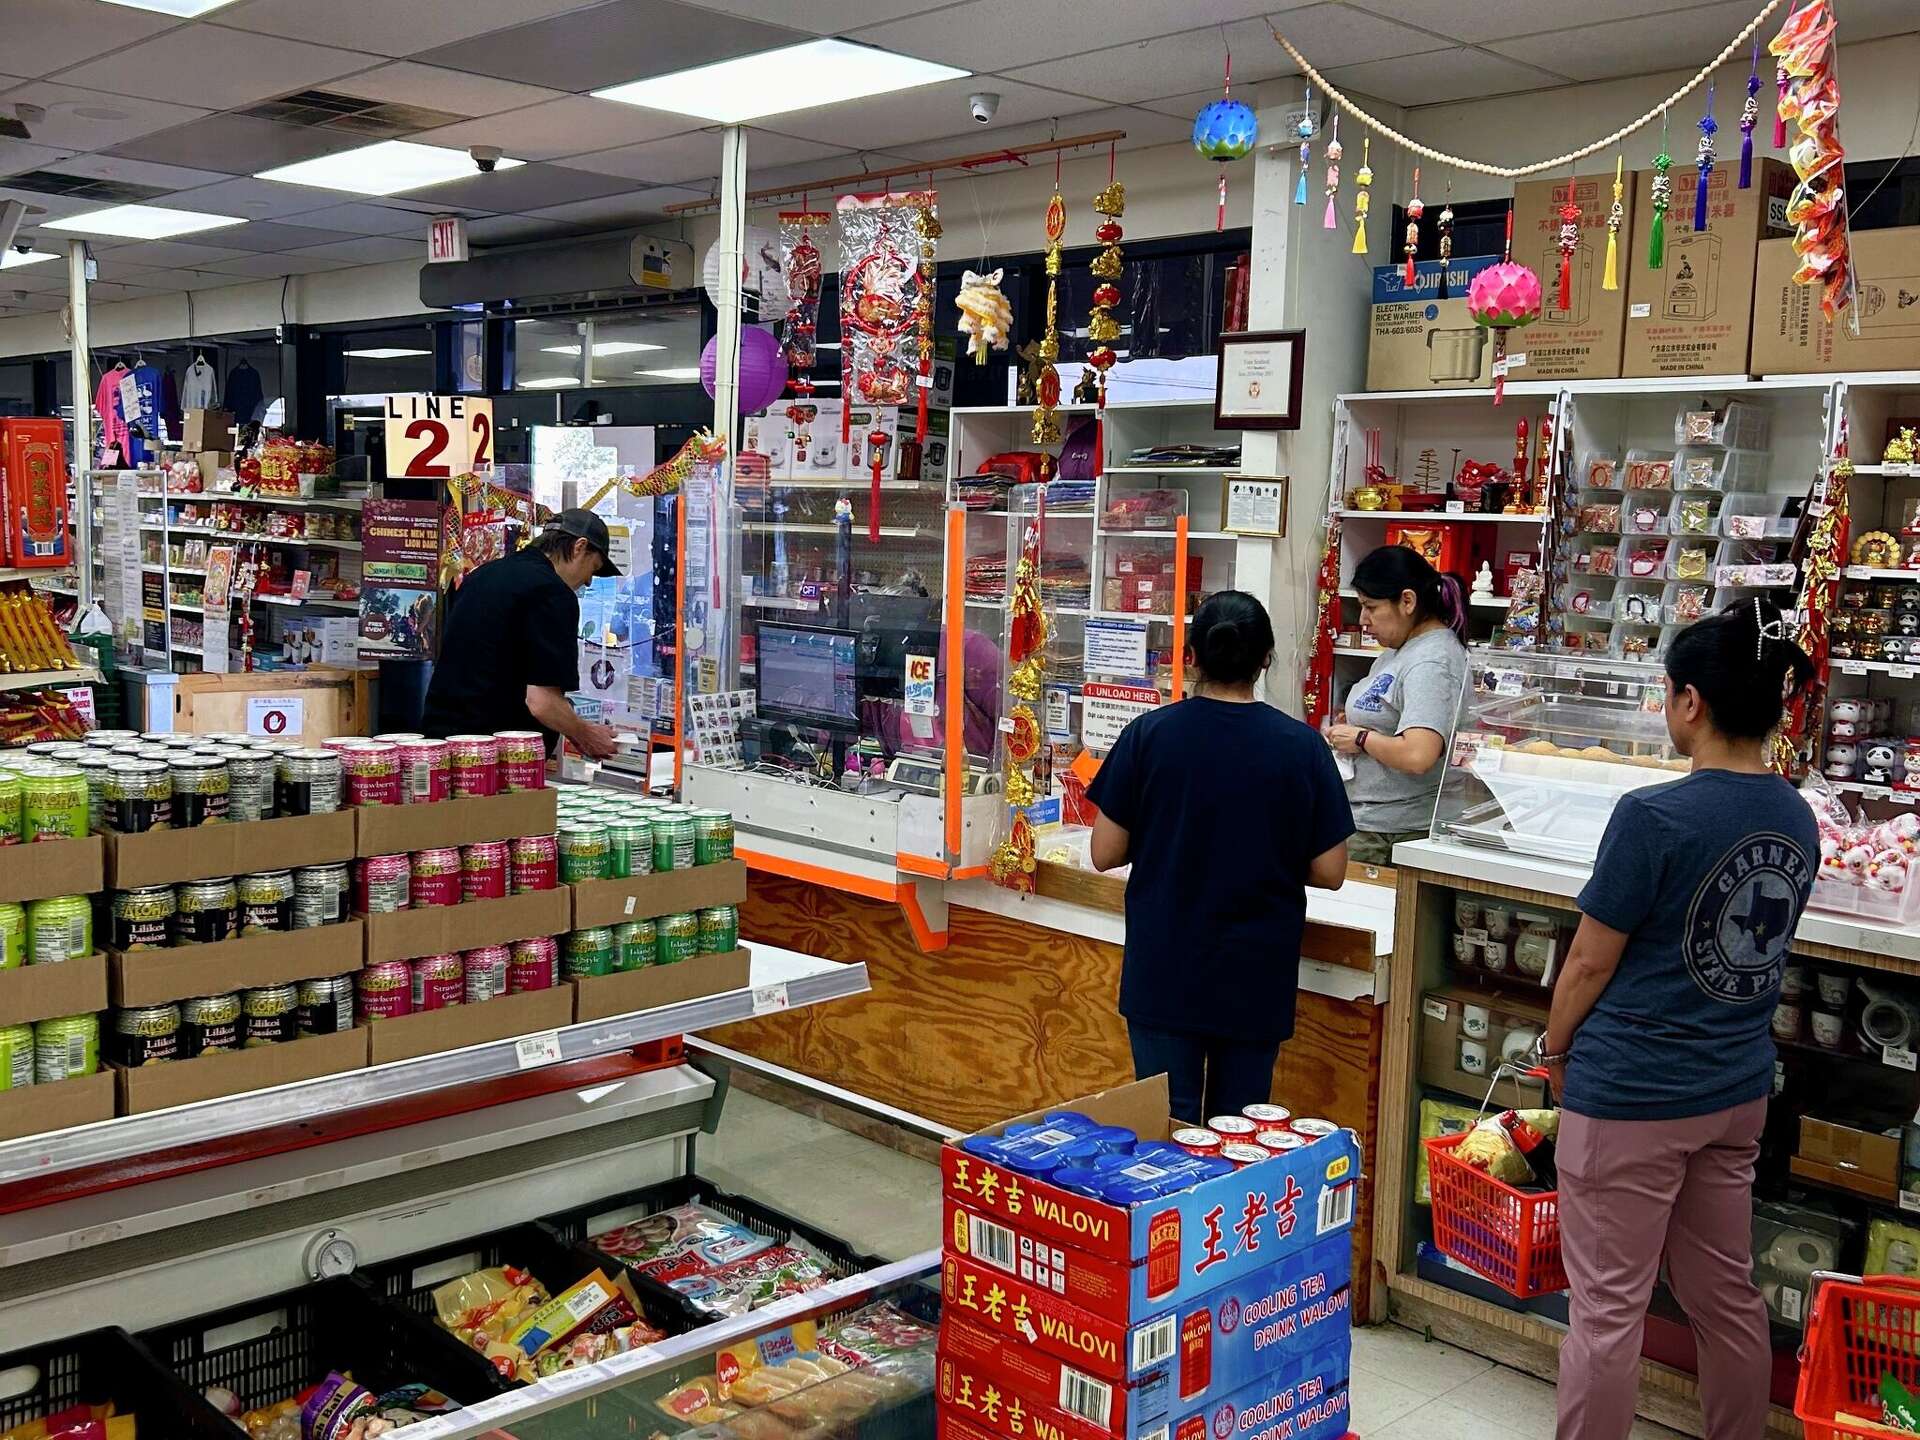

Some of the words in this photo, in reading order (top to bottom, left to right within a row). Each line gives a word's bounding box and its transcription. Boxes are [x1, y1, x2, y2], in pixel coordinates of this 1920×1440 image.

[432, 221, 455, 258] EXIT
[1403, 270, 1469, 292] OJIRSHI
[1375, 313, 1392, 322] RICE
[1393, 311, 1424, 321] WARMER
[1376, 304, 1410, 313] ELECTRIC
[388, 396, 464, 419] LINE
[472, 412, 491, 463] 2
[404, 419, 450, 478] 2
[369, 527, 409, 538] CHINESE
[410, 529, 425, 538] NEW
[426, 529, 438, 539] YEA
[404, 539, 421, 548] LION
[422, 540, 438, 548] DANC
[910, 660, 931, 680] ICE
[1087, 687, 1094, 695] 1.
[1096, 688, 1131, 699] UNLOAD
[1133, 691, 1156, 702] HERE
[352, 781, 396, 789] Strawberry
[360, 789, 388, 798] Guava
[567, 858, 591, 867] Island
[1717, 844, 1809, 893] GARNER
[122, 903, 170, 920] ALOHA
[129, 933, 167, 943] Passion
[131, 923, 166, 934] Lilikoi
[1695, 938, 1741, 993] STATE
[1752, 964, 1780, 993] PA
[205, 1025, 235, 1037] Lilikoi
[247, 1026, 282, 1037] Passion
[249, 1018, 280, 1028] Lilikoi
[146, 1036, 176, 1049] Lilikoi
[202, 1034, 236, 1046] Passion
[143, 1046, 177, 1059] Passion
[952, 1158, 1026, 1214] 王老吉
[1030, 1194, 1110, 1242] WALOVI
[1194, 1174, 1303, 1276] 王老吉
[1244, 1285, 1298, 1327] COOLING
[1300, 1272, 1326, 1301] TEA
[958, 1274, 1033, 1334] 王老吉
[1039, 1312, 1117, 1363] WALOVI
[1254, 1316, 1297, 1351] DRINK
[1299, 1288, 1349, 1328] WALOVI
[1182, 1321, 1211, 1343] WALOVI
[322, 1393, 344, 1418] Ball
[955, 1374, 1027, 1434] 王老吉
[1238, 1388, 1293, 1431] COOLING
[1297, 1375, 1324, 1404] TEA
[1296, 1391, 1347, 1431] WALOVI
